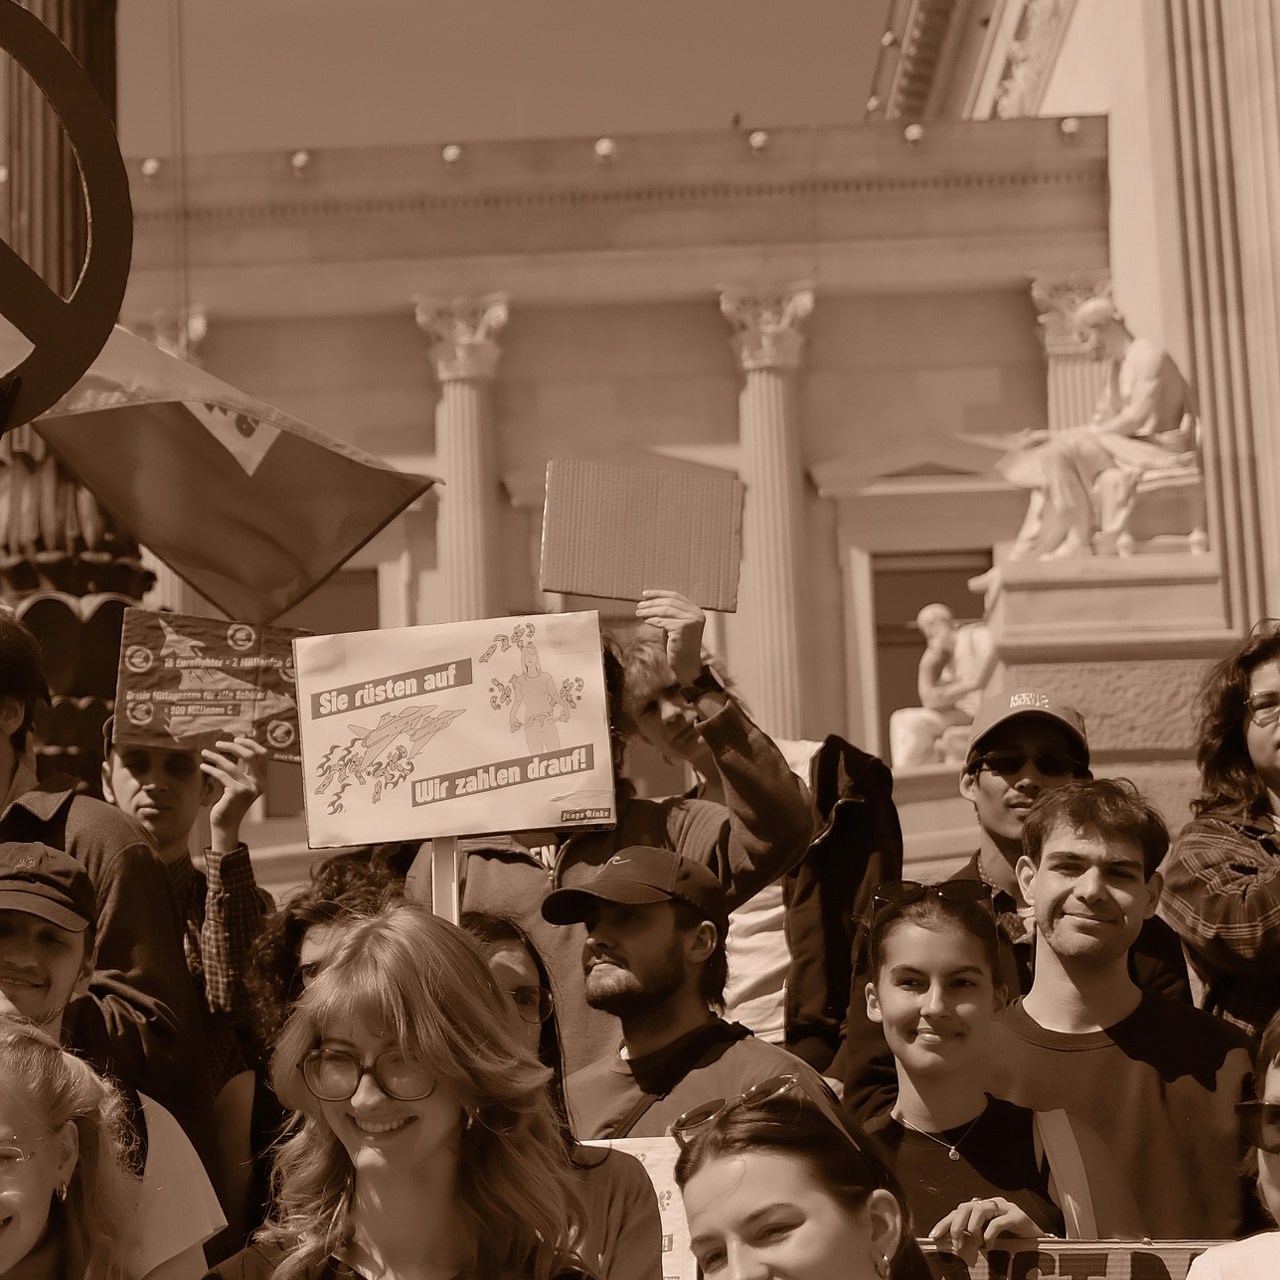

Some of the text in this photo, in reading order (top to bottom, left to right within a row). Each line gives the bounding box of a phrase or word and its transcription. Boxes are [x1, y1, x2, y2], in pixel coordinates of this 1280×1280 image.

[175, 658, 223, 669] Eurofighter
[232, 658, 238, 667] 2
[240, 657, 283, 668] Milliarden
[319, 664, 456, 715] Sie rüsten auf
[126, 690, 151, 700] Gratis
[152, 691, 201, 702] Mittagessen
[203, 690, 215, 700] für
[236, 690, 266, 701] Schüler
[170, 705, 185, 715] 900
[187, 705, 225, 715] Millionen
[415, 747, 586, 804] Wir zahlen drauf!
